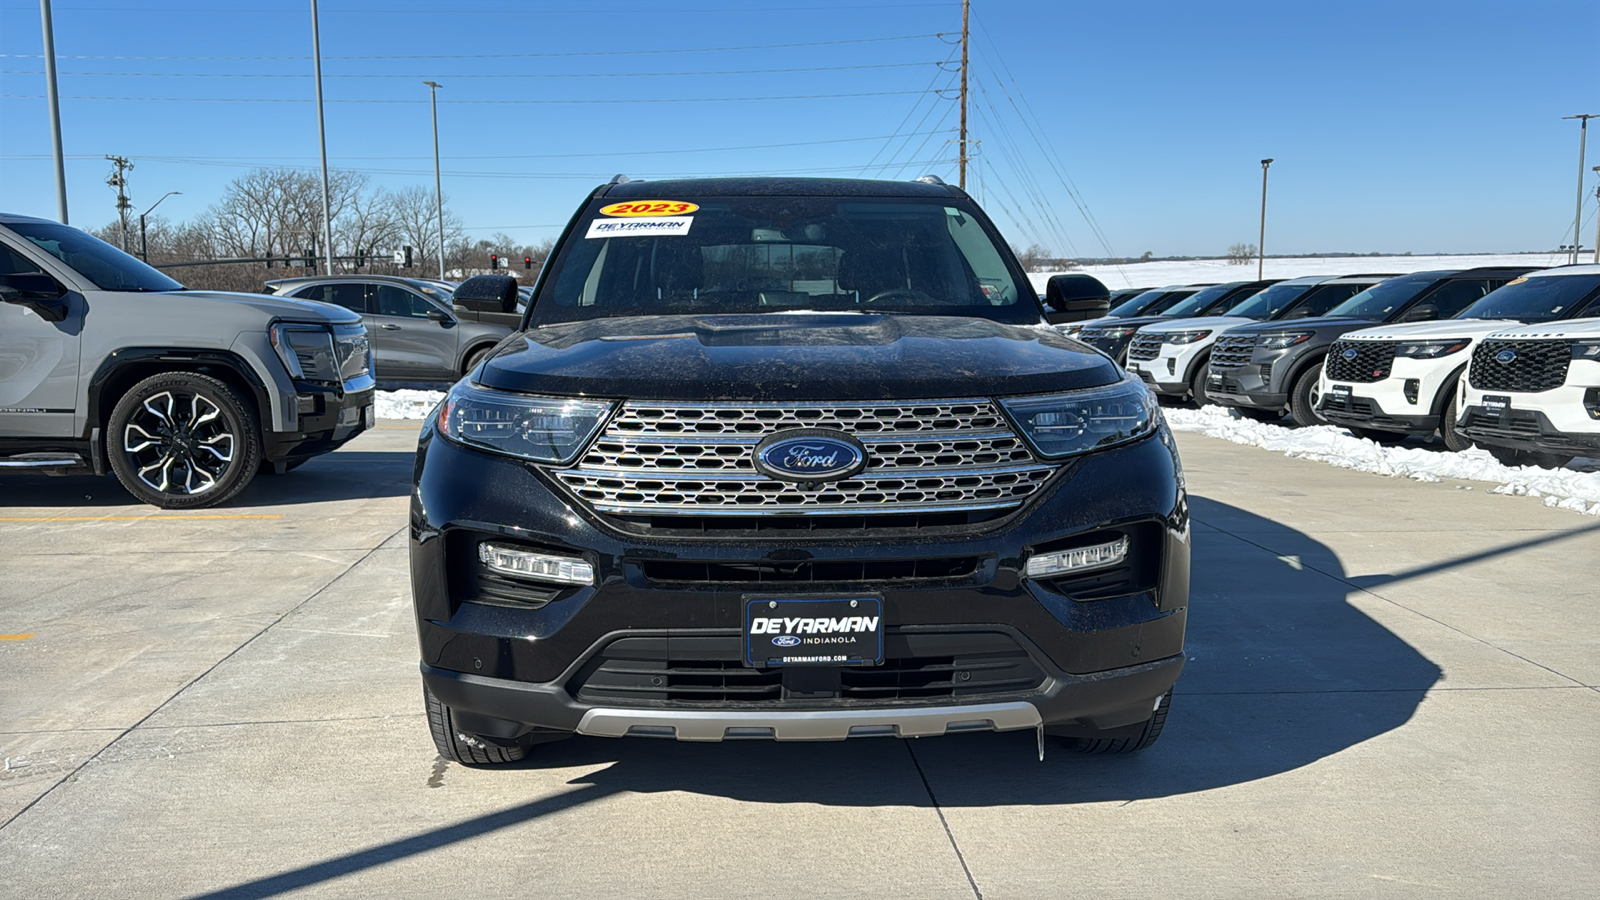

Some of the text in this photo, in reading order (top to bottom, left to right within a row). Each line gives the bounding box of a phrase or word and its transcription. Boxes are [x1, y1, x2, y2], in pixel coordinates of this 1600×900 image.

[610, 203, 690, 214] 2023
[596, 221, 686, 230] DEYARMAN
[783, 444, 839, 468] Ford
[750, 616, 879, 635] DEYARMAN
[776, 636, 857, 645] Ford INDIANOLA
[782, 655, 848, 663] DEYARMANFORD.COM
